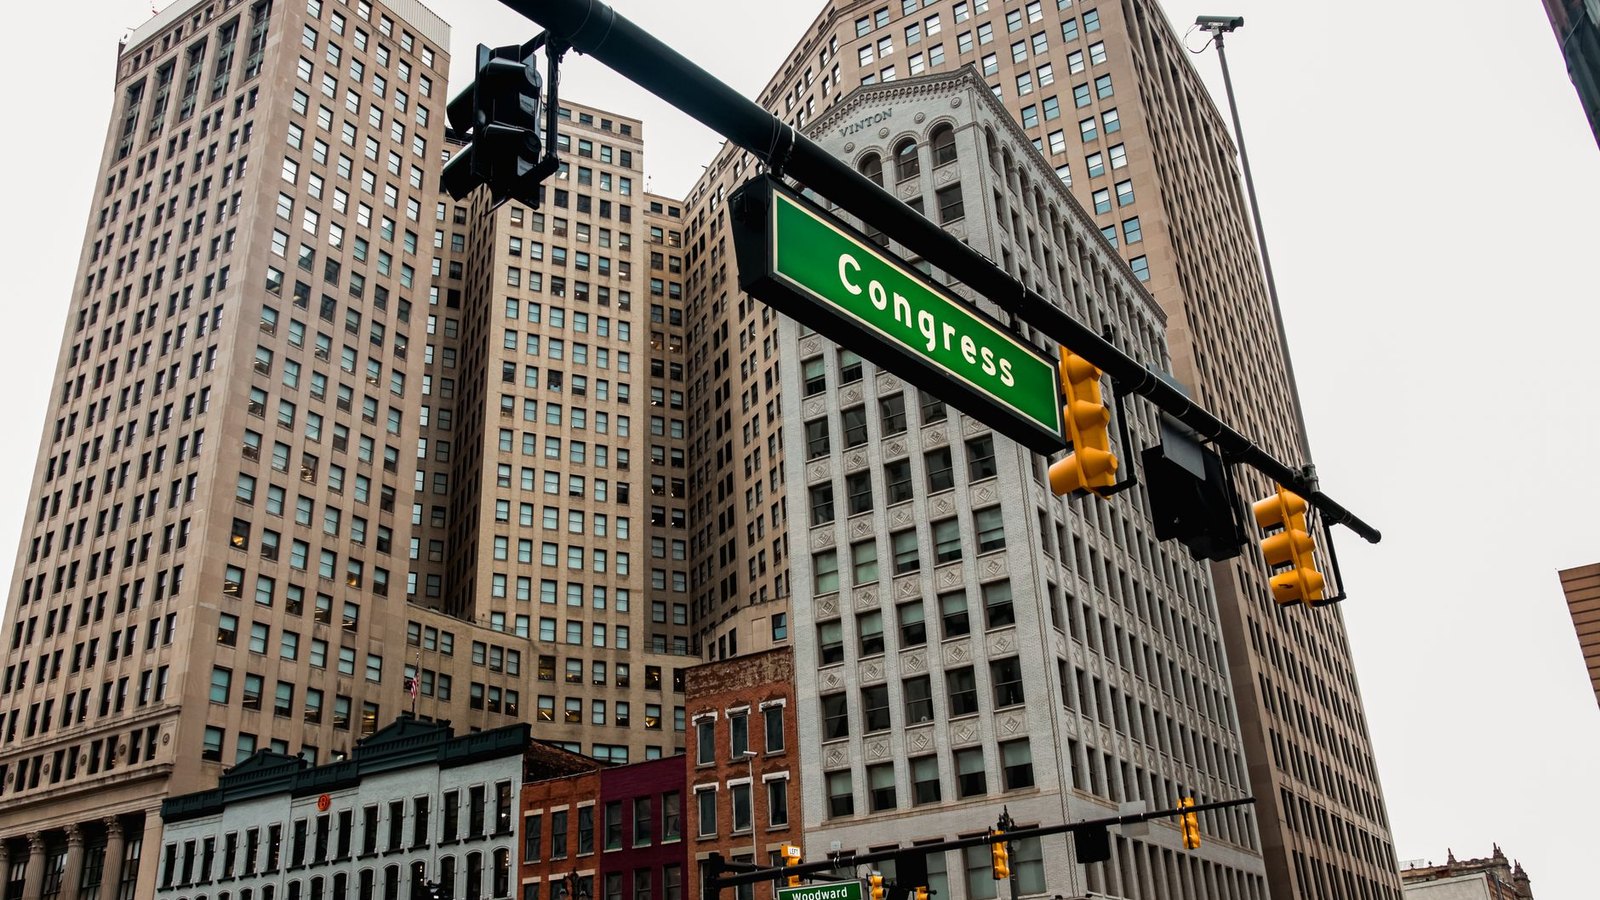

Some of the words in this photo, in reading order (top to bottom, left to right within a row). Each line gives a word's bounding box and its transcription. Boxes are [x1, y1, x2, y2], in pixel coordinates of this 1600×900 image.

[839, 108, 893, 137] VINTON
[839, 253, 1015, 387] Congress
[791, 887, 848, 900] Woodward
